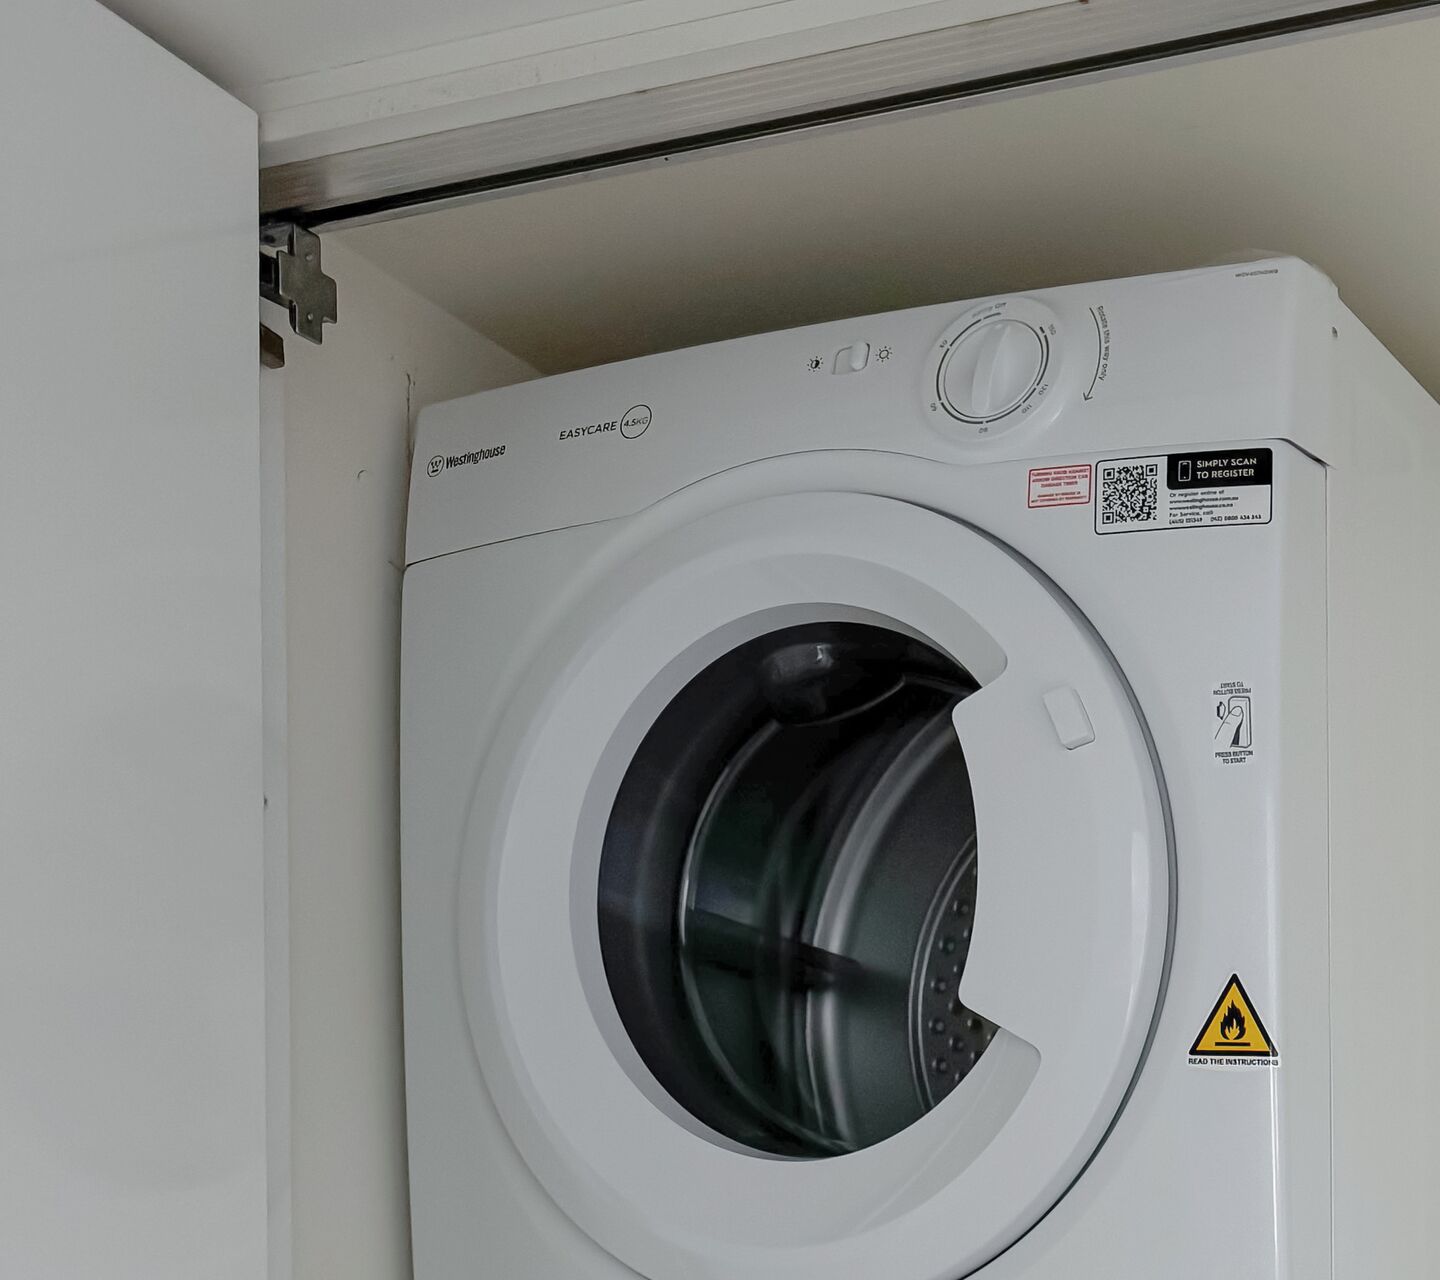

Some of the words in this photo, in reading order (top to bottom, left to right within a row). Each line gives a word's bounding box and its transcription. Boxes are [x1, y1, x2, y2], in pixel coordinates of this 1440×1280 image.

[559, 421, 618, 440] EASYCARE
[623, 416, 649, 428] 4.5KG
[446, 445, 506, 469] Westinghouse
[1196, 459, 1229, 468] SIMPLY
[1231, 458, 1257, 466] SCAN
[1196, 471, 1209, 479] TO
[1212, 468, 1255, 478] REGISTER
[1210, 1058, 1224, 1066] THE
